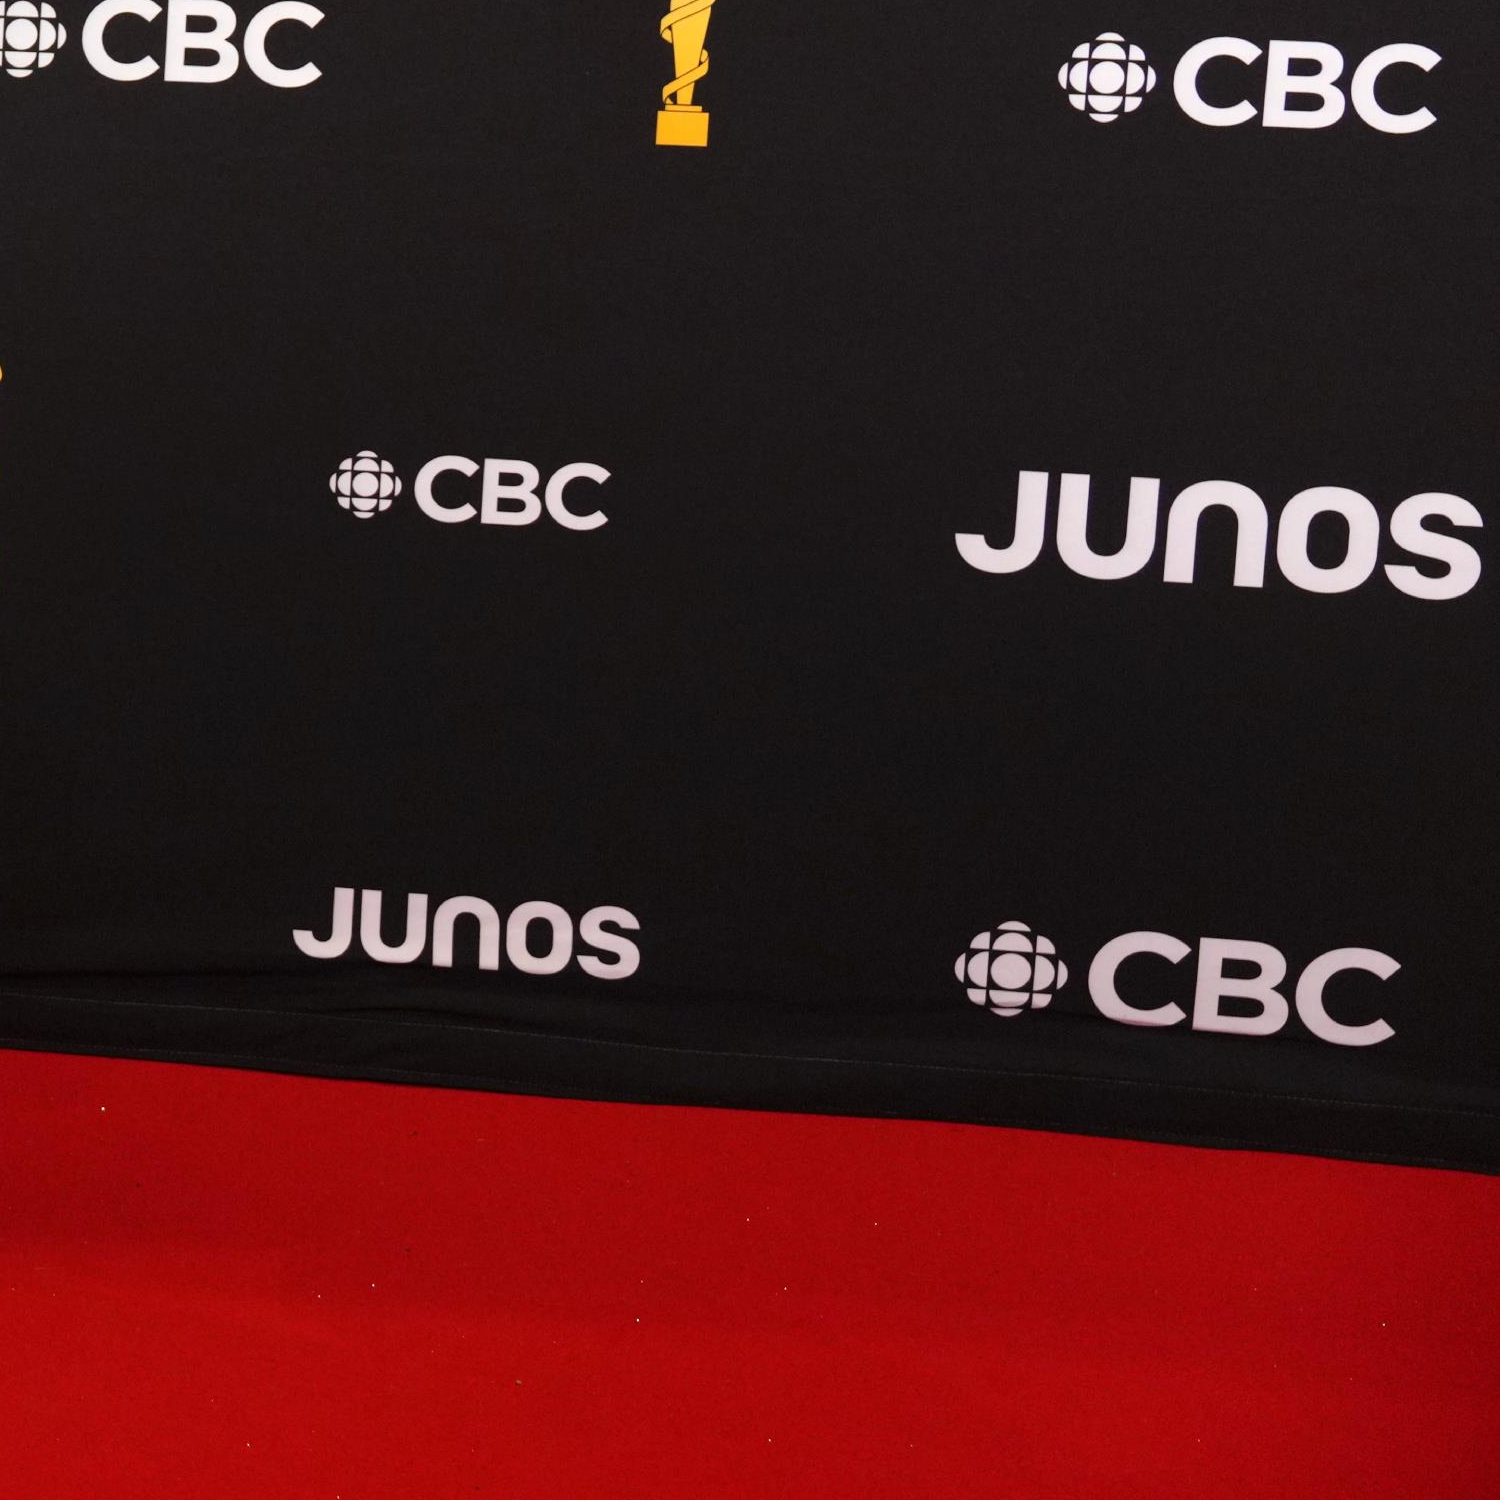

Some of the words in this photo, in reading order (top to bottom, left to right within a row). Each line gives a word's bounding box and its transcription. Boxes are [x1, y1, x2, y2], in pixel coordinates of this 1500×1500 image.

[1173, 36, 1442, 134] CBC
[414, 455, 612, 531] CBC
[954, 470, 1484, 601] JUNOS
[292, 886, 641, 980] JUNOS
[1087, 930, 1402, 1047] CBC
